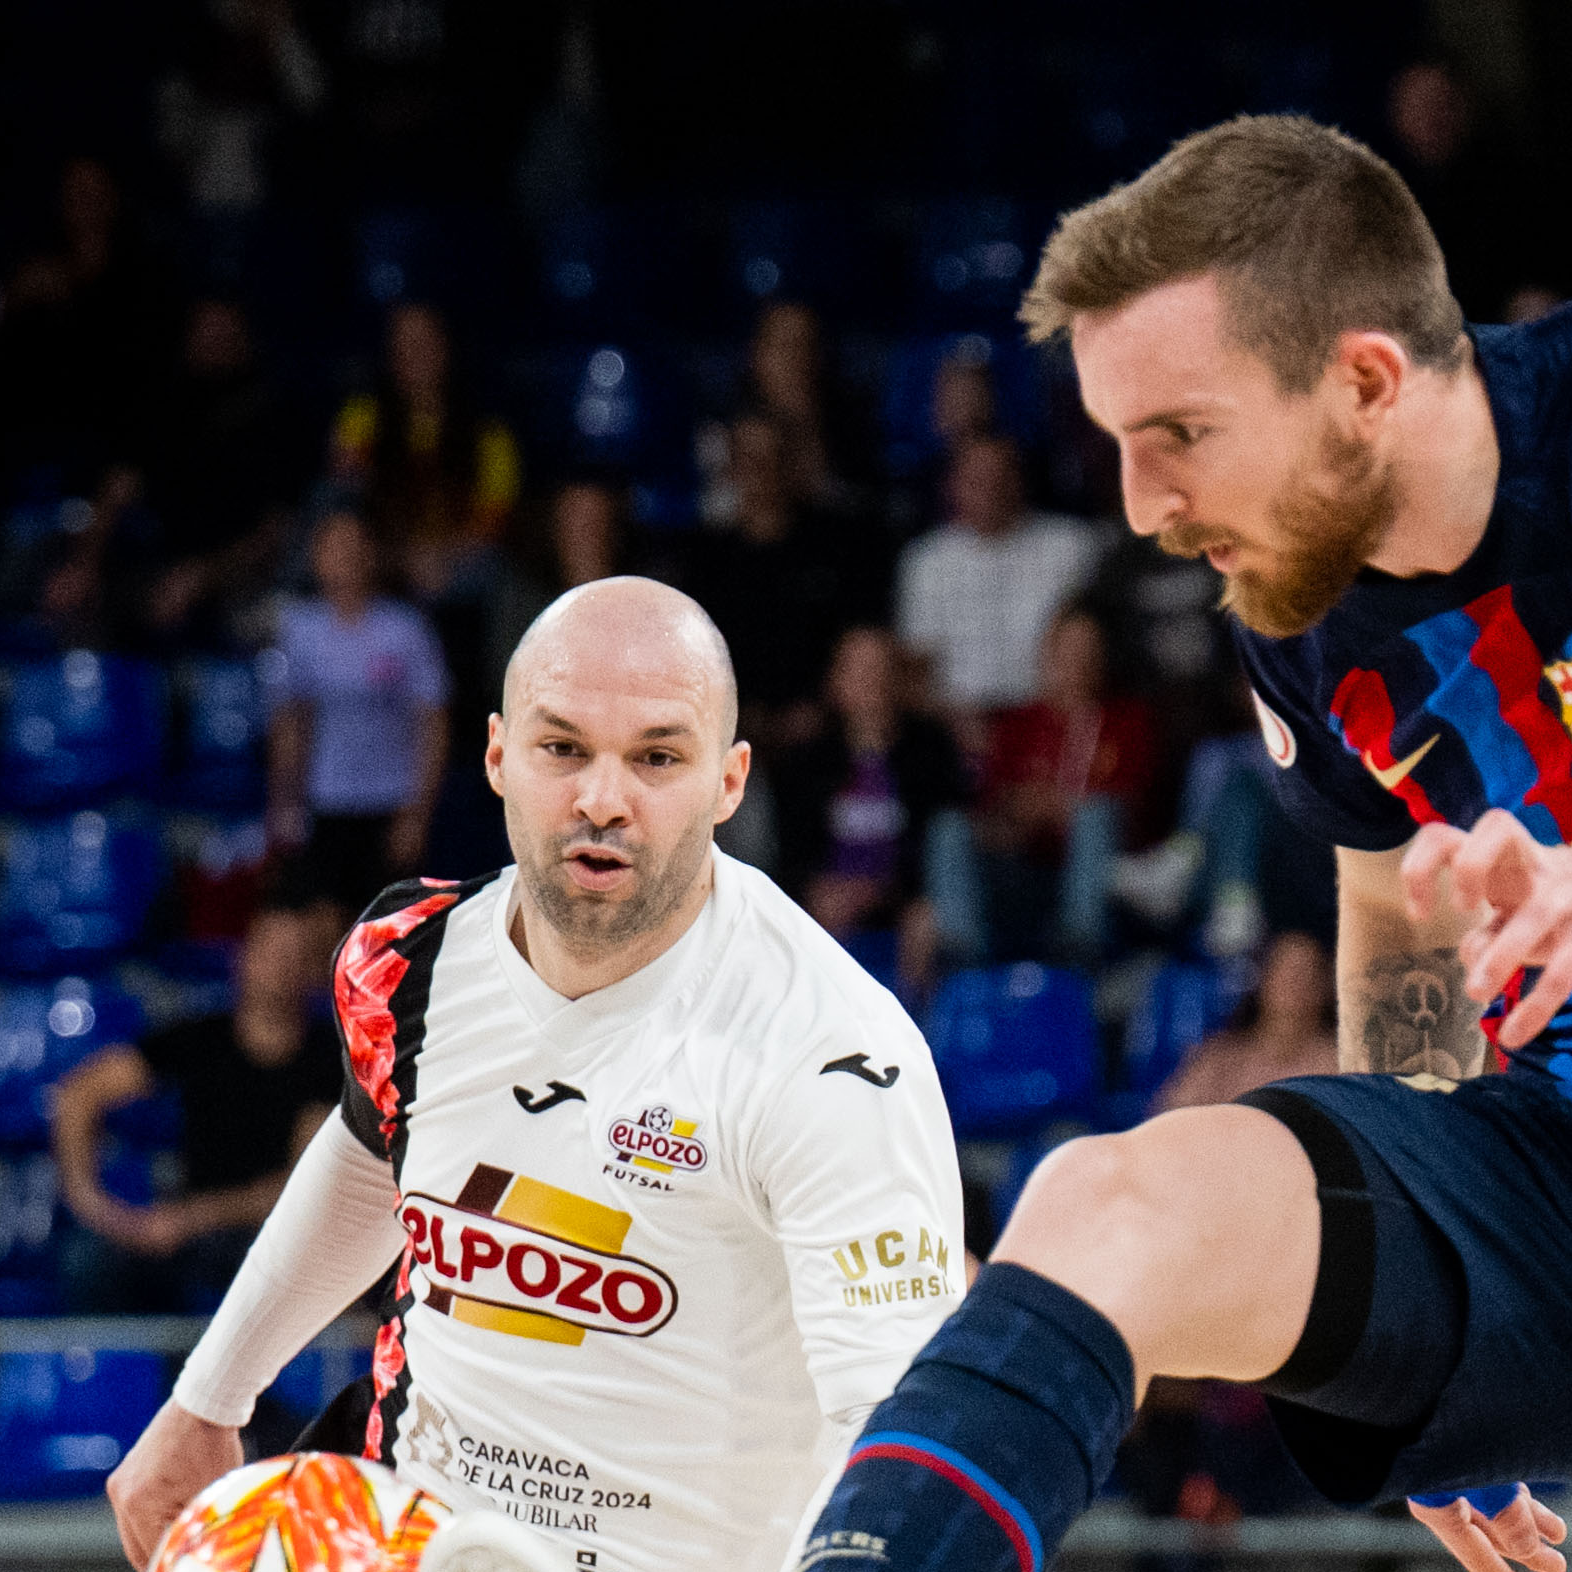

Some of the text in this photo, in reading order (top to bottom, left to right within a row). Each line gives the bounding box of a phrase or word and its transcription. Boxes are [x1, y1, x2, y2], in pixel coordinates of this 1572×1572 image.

[602, 1164, 675, 1191] FUTSAL
[458, 1435, 590, 1481] CARAVACA
[458, 1458, 653, 1510] DE LA CRUZ 2024
